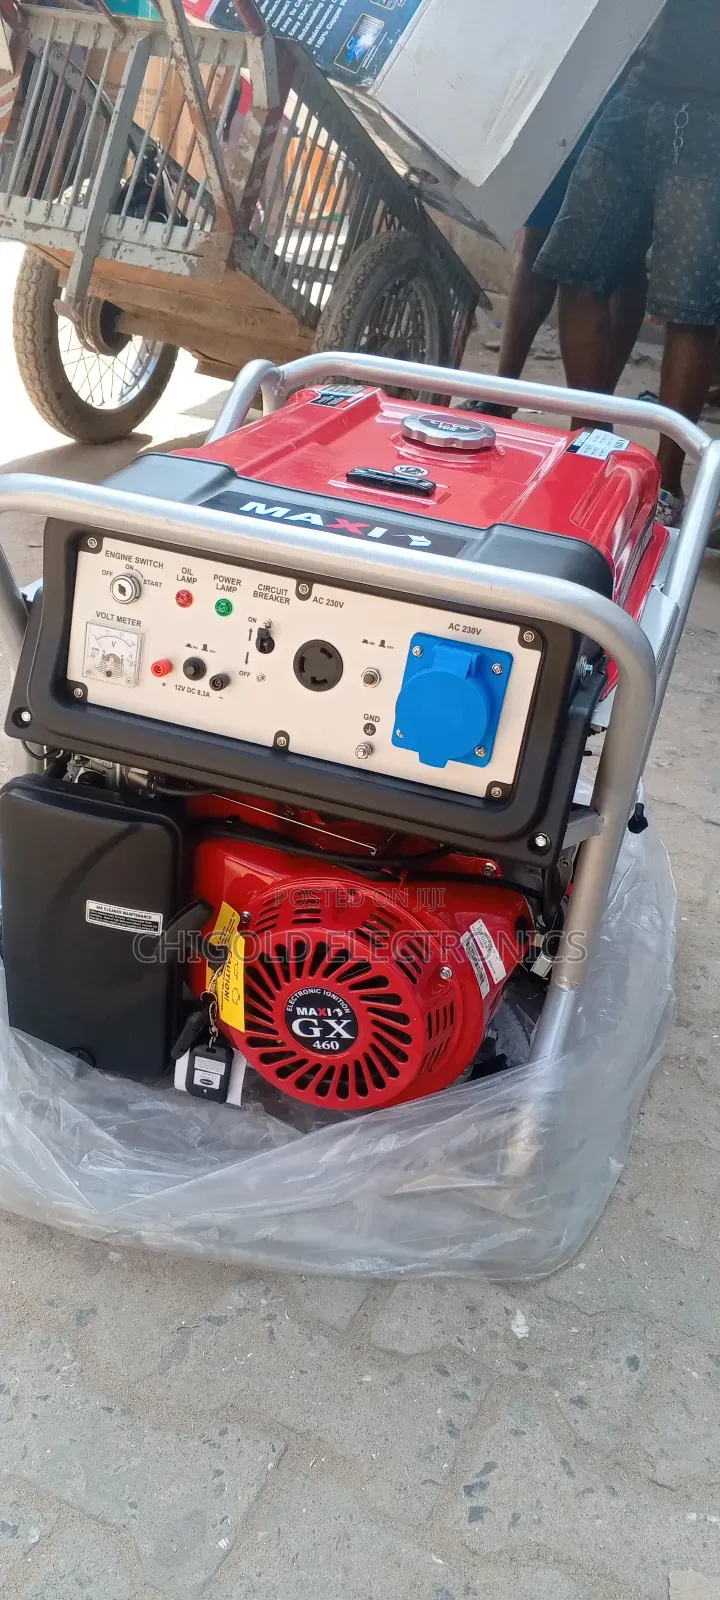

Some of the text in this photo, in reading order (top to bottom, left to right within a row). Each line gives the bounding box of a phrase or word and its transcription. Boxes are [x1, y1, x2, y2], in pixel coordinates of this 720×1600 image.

[280, 17, 292, 32] Easy
[289, 8, 297, 16] To
[298, 2, 324, 40] Outstanding
[307, 4, 334, 45] Maintenance
[288, 21, 300, 36] Easy
[315, 31, 328, 48] 100%
[326, 7, 342, 30] Copper
[239, 501, 389, 538] MAXI
[105, 550, 164, 569] ENGINE SWITCH
[101, 569, 114, 577] OFF
[181, 567, 194, 576] OIL
[143, 579, 162, 588] START
[176, 574, 198, 584] LAMP
[213, 574, 242, 587] POWER
[216, 583, 238, 593] LAMP
[257, 583, 289, 597] CIRCUIT
[253, 591, 291, 605] BREAKER
[312, 597, 345, 609] AC 230V
[96, 611, 142, 627] VOLT METER
[448, 623, 482, 636] AC 230V
[174, 684, 186, 692] 12V
[197, 690, 211, 698] 8.3A
[363, 713, 380, 723] GND
[286, 988, 351, 1014] ELECTRONIC IGNITION
[296, 1007, 332, 1017] MAXI
[291, 1018, 355, 1039] GX
[312, 1040, 340, 1050] 460
